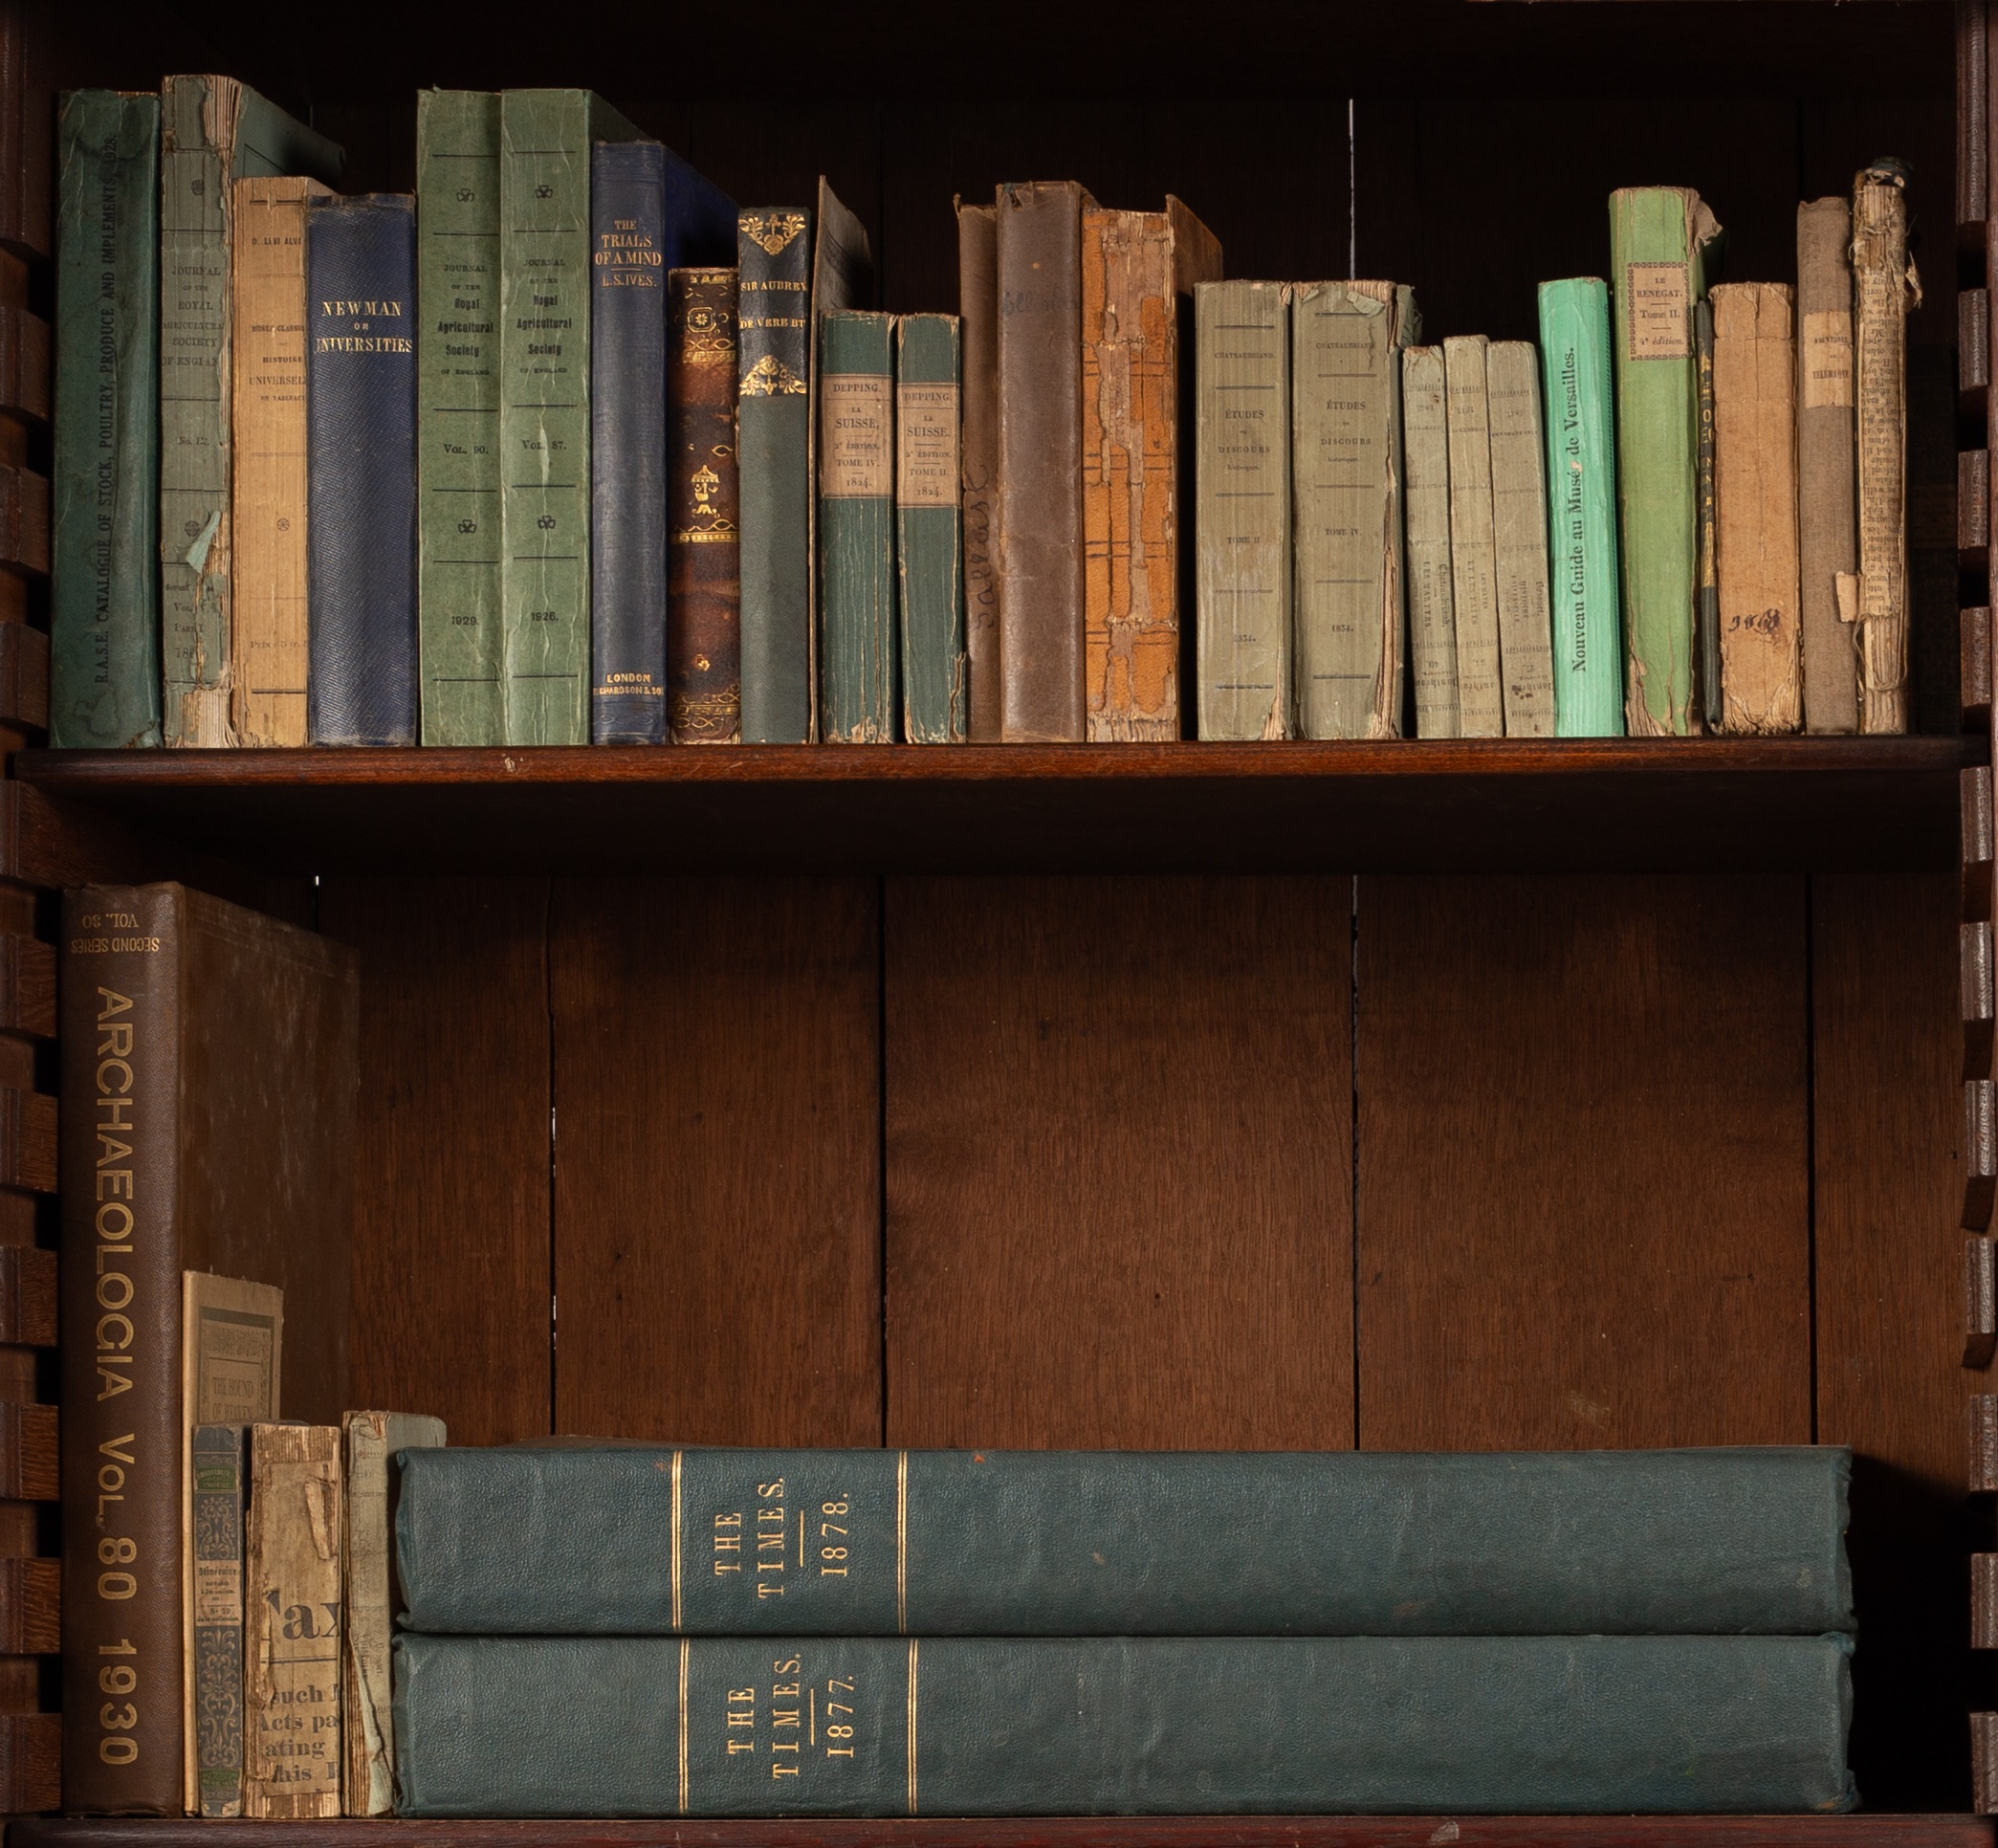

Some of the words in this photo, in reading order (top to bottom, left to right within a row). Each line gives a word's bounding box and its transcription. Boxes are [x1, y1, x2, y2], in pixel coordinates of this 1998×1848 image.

[102, 134, 118, 165] 1928.
[614, 219, 637, 231] THE
[601, 234, 652, 249] TRIALS
[522, 258, 566, 267] JOURNAL
[595, 251, 611, 266] OF
[612, 252, 624, 265] A
[624, 251, 662, 267] MIND
[171, 266, 221, 276] JOURNAL
[443, 264, 488, 273] JOURNAL
[100, 272, 115, 300] AND
[740, 280, 758, 292] SIR
[760, 280, 808, 292] AUBREY
[178, 300, 213, 311] ROYAL
[454, 297, 480, 311] Royal
[533, 294, 559, 307] Royal
[321, 300, 402, 317] NEWMAN
[1639, 309, 1666, 319] Tome
[1669, 309, 1680, 319] II.
[353, 321, 369, 331] ON
[437, 320, 494, 335] Agricultural
[516, 318, 573, 331] Agricultural
[739, 318, 755, 330] DE
[757, 318, 788, 328] VERE
[99, 308, 115, 373] PRODUCE
[172, 338, 218, 346] SOCIETY
[445, 343, 480, 358] Society
[528, 343, 562, 356] Society
[177, 356, 219, 366] ENGLAN
[833, 383, 882, 393] DEPPING.
[1561, 347, 1579, 432] Versailles.
[904, 392, 953, 402] DEPPING.
[1326, 399, 1367, 410] ÉTUDES
[99, 381, 115, 449] POULTRY,
[1224, 408, 1264, 420] ÉTUDES
[907, 426, 951, 437] SUISSE.
[473, 445, 489, 454] 90.
[1564, 436, 1580, 455] de
[836, 458, 863, 467] TOME
[866, 458, 880, 468] IV.
[909, 468, 936, 476] TOME
[938, 468, 949, 476] II.
[98, 455, 113, 506] STOCK,
[845, 477, 872, 489] 1824.
[1567, 459, 1584, 515] Musé
[916, 487, 943, 498] 1824.
[99, 513, 111, 532] OF
[1572, 519, 1584, 540] au
[1324, 527, 1348, 537] TOME
[1226, 536, 1252, 545] TOME
[1569, 546, 1585, 595] Guide
[95, 539, 111, 623] CATALOGUE
[451, 615, 479, 626] 1929.
[1571, 601, 1587, 672] Nouveau
[95, 631, 110, 684] R.A.S.E.
[605, 672, 651, 684] LONDON
[81, 913, 101, 929] 30
[105, 913, 140, 928] VOL.
[71, 937, 109, 954] SERIES
[111, 936, 161, 953] SECOND
[96, 986, 135, 1401] ARCHAEOLOGIA
[212, 1376, 228, 1396] THE
[228, 1377, 254, 1398] HOUND
[757, 1477, 785, 1598] TIMES.
[821, 1491, 849, 1577] 1878.
[714, 1511, 742, 1576] THE
[97, 1535, 138, 1602] 80
[98, 1638, 140, 1766] 1930
[273, 1684, 323, 1705] such
[727, 1686, 755, 1754] THE
[772, 1653, 801, 1779] TIMES.
[826, 1675, 855, 1758] 1877.
